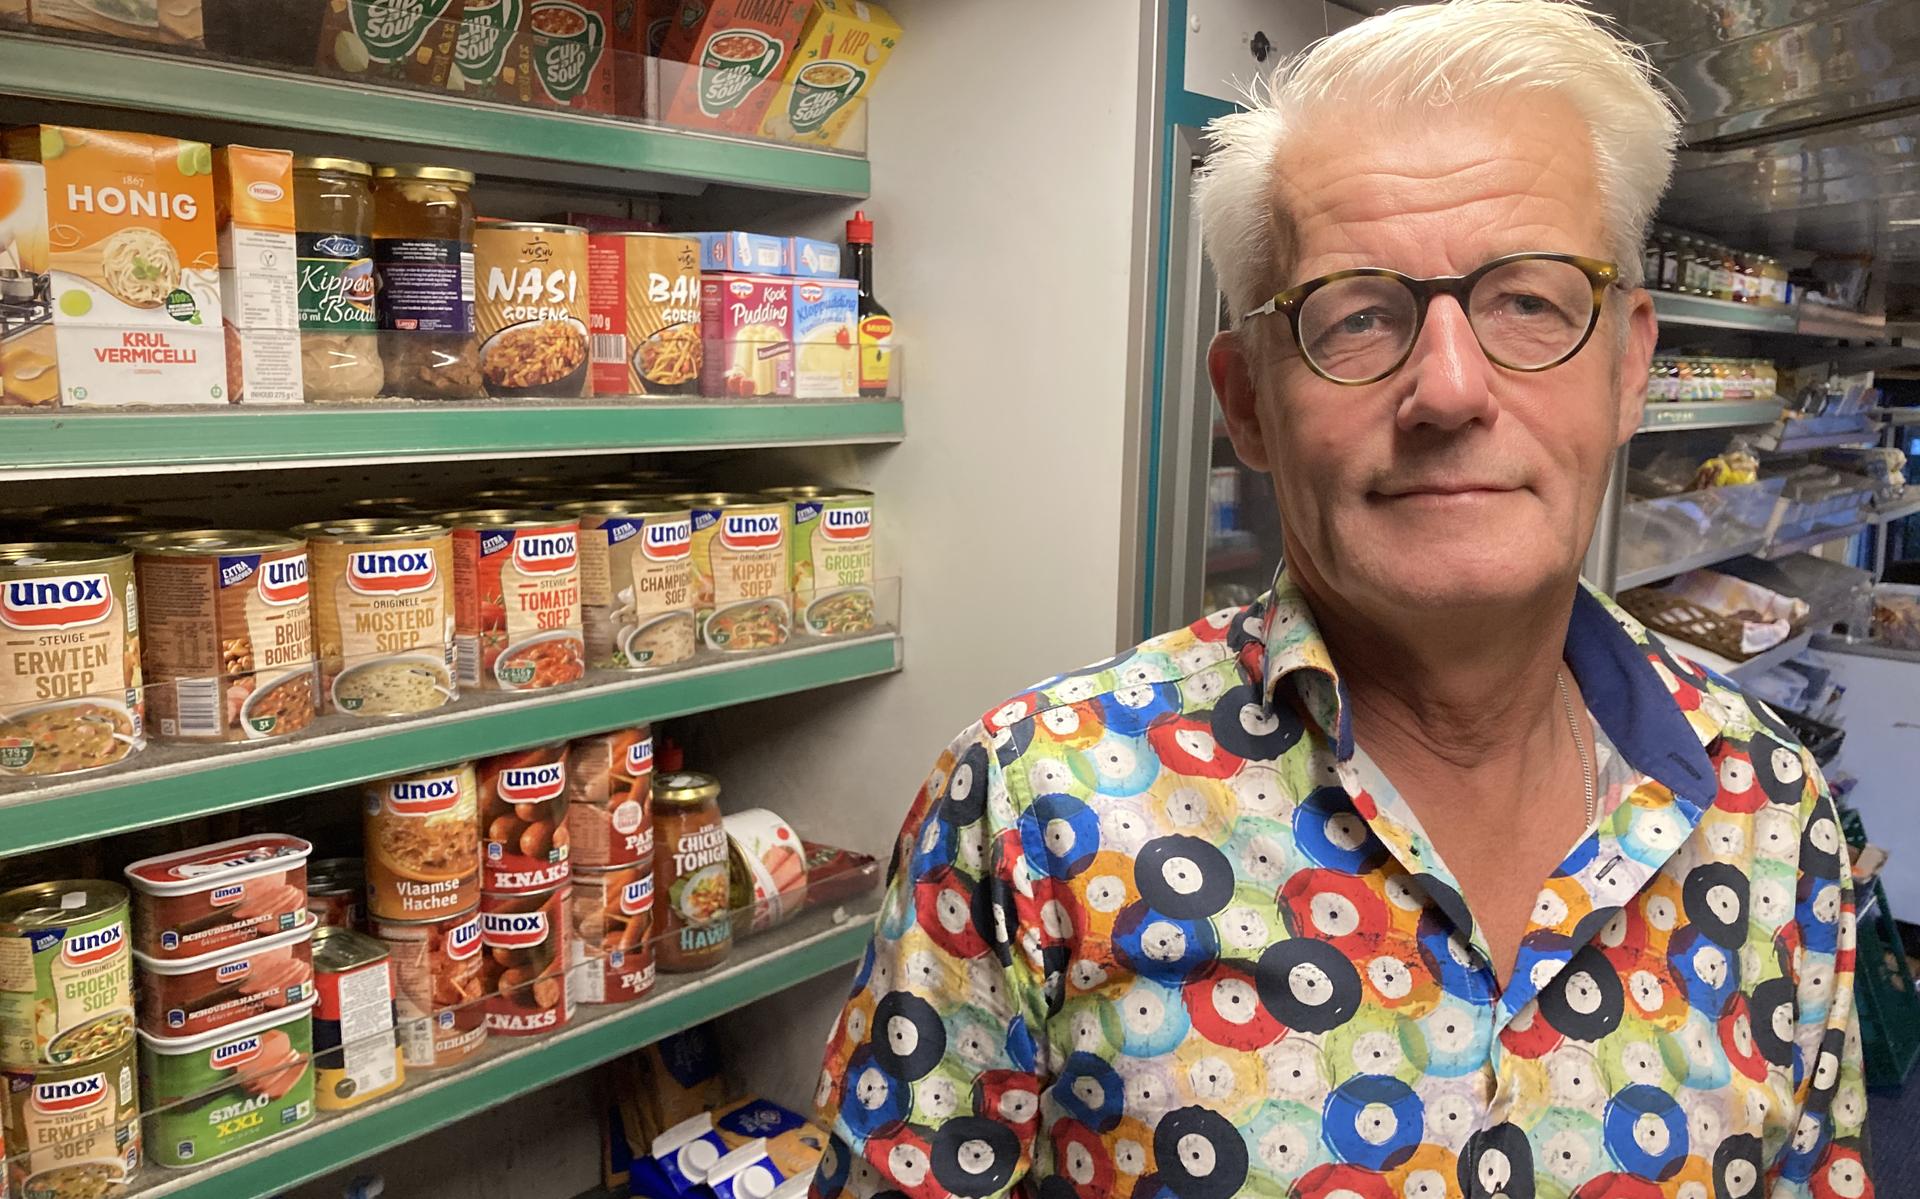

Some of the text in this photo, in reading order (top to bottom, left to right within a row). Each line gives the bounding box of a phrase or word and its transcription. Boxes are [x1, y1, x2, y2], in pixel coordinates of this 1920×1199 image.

[455, 28, 499, 60] SOUP
[838, 28, 870, 56] KIP
[547, 50, 586, 83] SOUP
[705, 73, 752, 99] SOUP
[793, 96, 838, 120] SOUP
[122, 176, 145, 187] 1867
[67, 184, 198, 221] HONIG
[488, 267, 577, 304] NASI
[764, 287, 788, 303] Kook
[309, 312, 321, 321] ml
[503, 306, 569, 321] GORENG
[605, 317, 610, 330] g
[730, 302, 788, 327] Pudding
[122, 332, 170, 348] KRUL
[94, 347, 197, 364] VERMICELLI
[729, 516, 779, 534] unox
[829, 511, 870, 526] unox
[523, 536, 575, 557] unox
[222, 561, 249, 579] EXTRA
[357, 553, 429, 574] unox
[731, 562, 778, 582] KIPPEN
[825, 552, 871, 572] GROENTE
[740, 580, 773, 598] SOEP
[838, 570, 865, 587] SOEP
[10, 579, 104, 607] unox
[373, 597, 420, 609] ORIGINELE
[518, 587, 578, 612] TOMATEN
[665, 588, 688, 606] SOEP
[355, 607, 435, 633] MOSTERD
[537, 608, 571, 630] SOEP
[39, 633, 86, 646] STEVIGE
[376, 630, 421, 653] SOEP
[14, 643, 109, 676] ERWTEN
[35, 670, 95, 700] SOEP
[507, 767, 560, 786] unox
[394, 779, 455, 800] unox
[495, 861, 569, 888] KNAKS
[215, 885, 242, 898] unox
[397, 878, 460, 896] Vlaamse
[403, 893, 458, 911] Hachee
[485, 915, 540, 931] unox
[71, 925, 121, 952] unox
[220, 962, 248, 976] unox
[65, 964, 127, 1000] GROENTE
[83, 986, 118, 1013] SOEP
[216, 1038, 257, 1059] unox
[40, 1077, 99, 1100] unox
[38, 1115, 107, 1144] ERWTEN
[217, 1111, 264, 1138] XXL
[53, 1137, 95, 1161] SOEP
